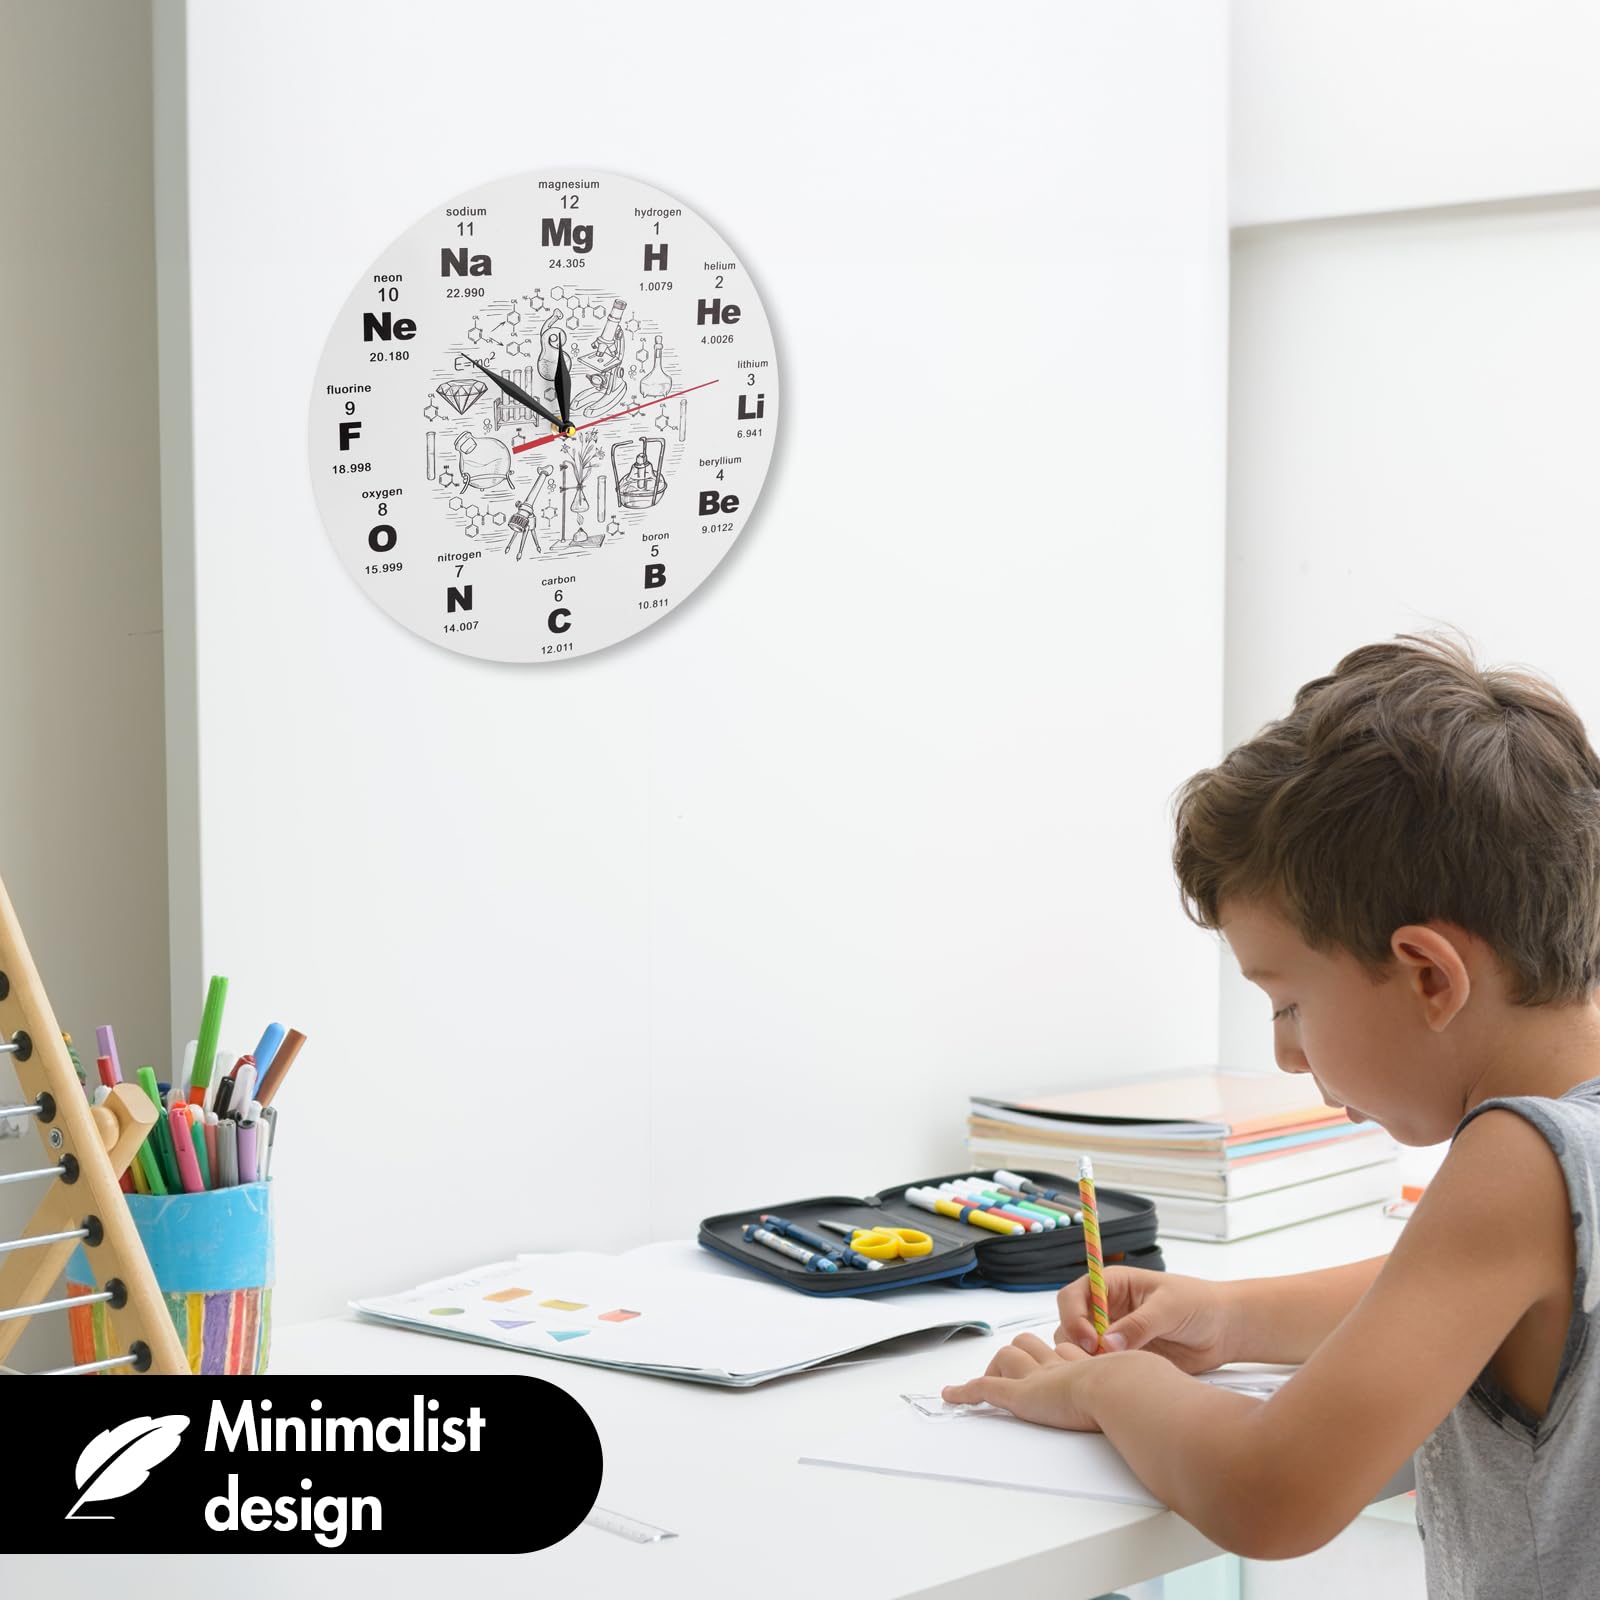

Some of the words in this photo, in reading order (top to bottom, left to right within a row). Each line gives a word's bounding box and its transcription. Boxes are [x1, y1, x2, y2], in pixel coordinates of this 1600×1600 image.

[539, 180, 599, 191] magnesium
[561, 195, 579, 209] 12
[446, 207, 486, 216] sodium
[635, 208, 682, 219] hydrogen
[457, 222, 473, 236] 11
[653, 222, 660, 235] 1
[542, 218, 593, 254] Mg
[441, 248, 492, 277] Na
[549, 259, 585, 268] 24.305
[644, 244, 668, 271] H
[704, 261, 736, 271] helium
[373, 274, 403, 283] neon
[715, 276, 723, 288] 2
[639, 281, 673, 292] 1.0079
[378, 287, 398, 302] 10
[447, 288, 484, 298] 22.990
[697, 298, 741, 325] He
[363, 312, 417, 342] Ne
[701, 335, 734, 345] 4.0026
[370, 351, 409, 362] 20.180
[737, 360, 769, 369] lithium
[747, 374, 755, 386] 3
[326, 384, 371, 394] fluorine
[345, 401, 355, 415] 9
[738, 394, 764, 420] Li
[339, 421, 362, 451] F
[737, 429, 763, 439] 6.941
[699, 456, 742, 468] beryllium
[332, 463, 371, 474] 18.998
[715, 469, 725, 481] 4
[362, 489, 402, 499] oxygen
[378, 503, 387, 516] 8
[699, 491, 739, 516] Be
[702, 523, 733, 534] 9.0122
[368, 525, 397, 552] O
[641, 532, 670, 542] boron
[438, 551, 481, 562] nitrogen
[651, 545, 659, 557] 5
[365, 562, 402, 574] 15.999
[455, 565, 464, 578] 7
[542, 576, 575, 586] carbon
[644, 563, 666, 589] B
[447, 585, 472, 613] N
[555, 590, 563, 602] 6
[638, 598, 669, 610] 10.811
[548, 608, 571, 633] C
[443, 621, 479, 634] 14.007
[541, 642, 573, 654] 12.011
